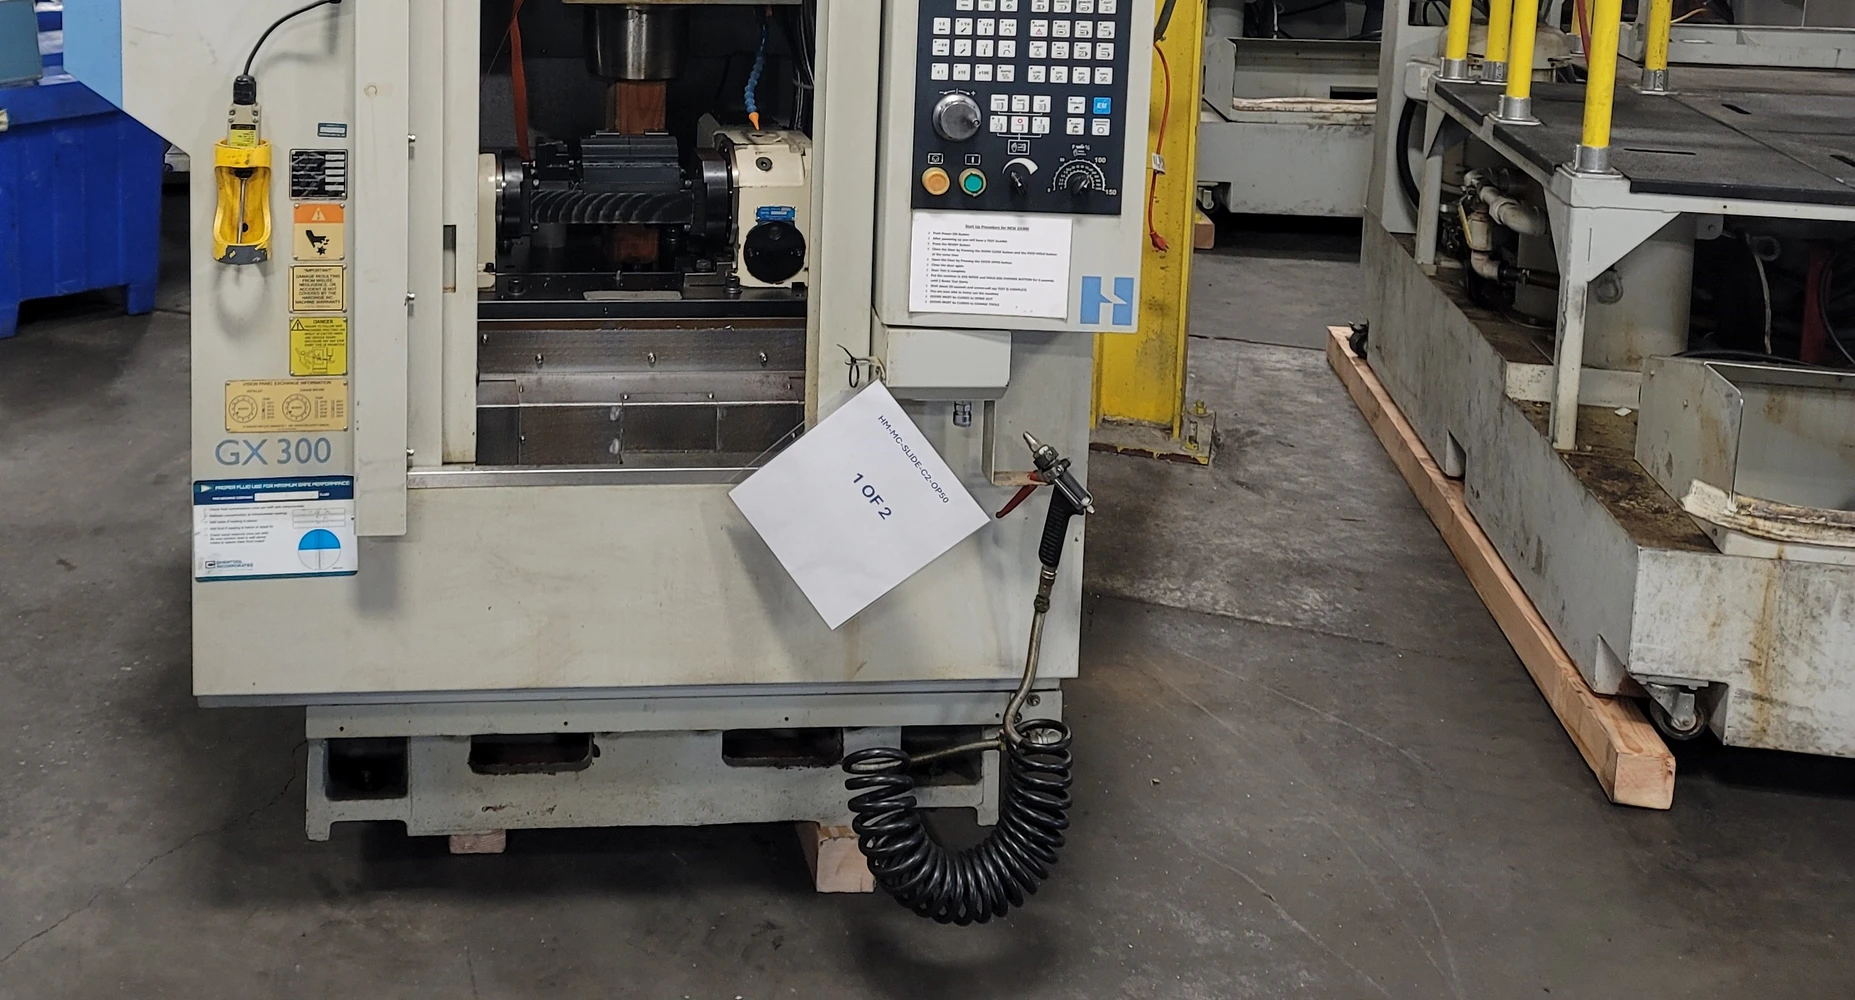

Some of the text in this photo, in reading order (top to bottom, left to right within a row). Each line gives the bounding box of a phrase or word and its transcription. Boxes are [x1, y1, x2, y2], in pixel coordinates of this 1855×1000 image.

[215, 437, 332, 466] GX 300
[877, 414, 950, 504] HM-MC-SLIDE-C2-OP50
[852, 472, 893, 520] 1 OF 2
